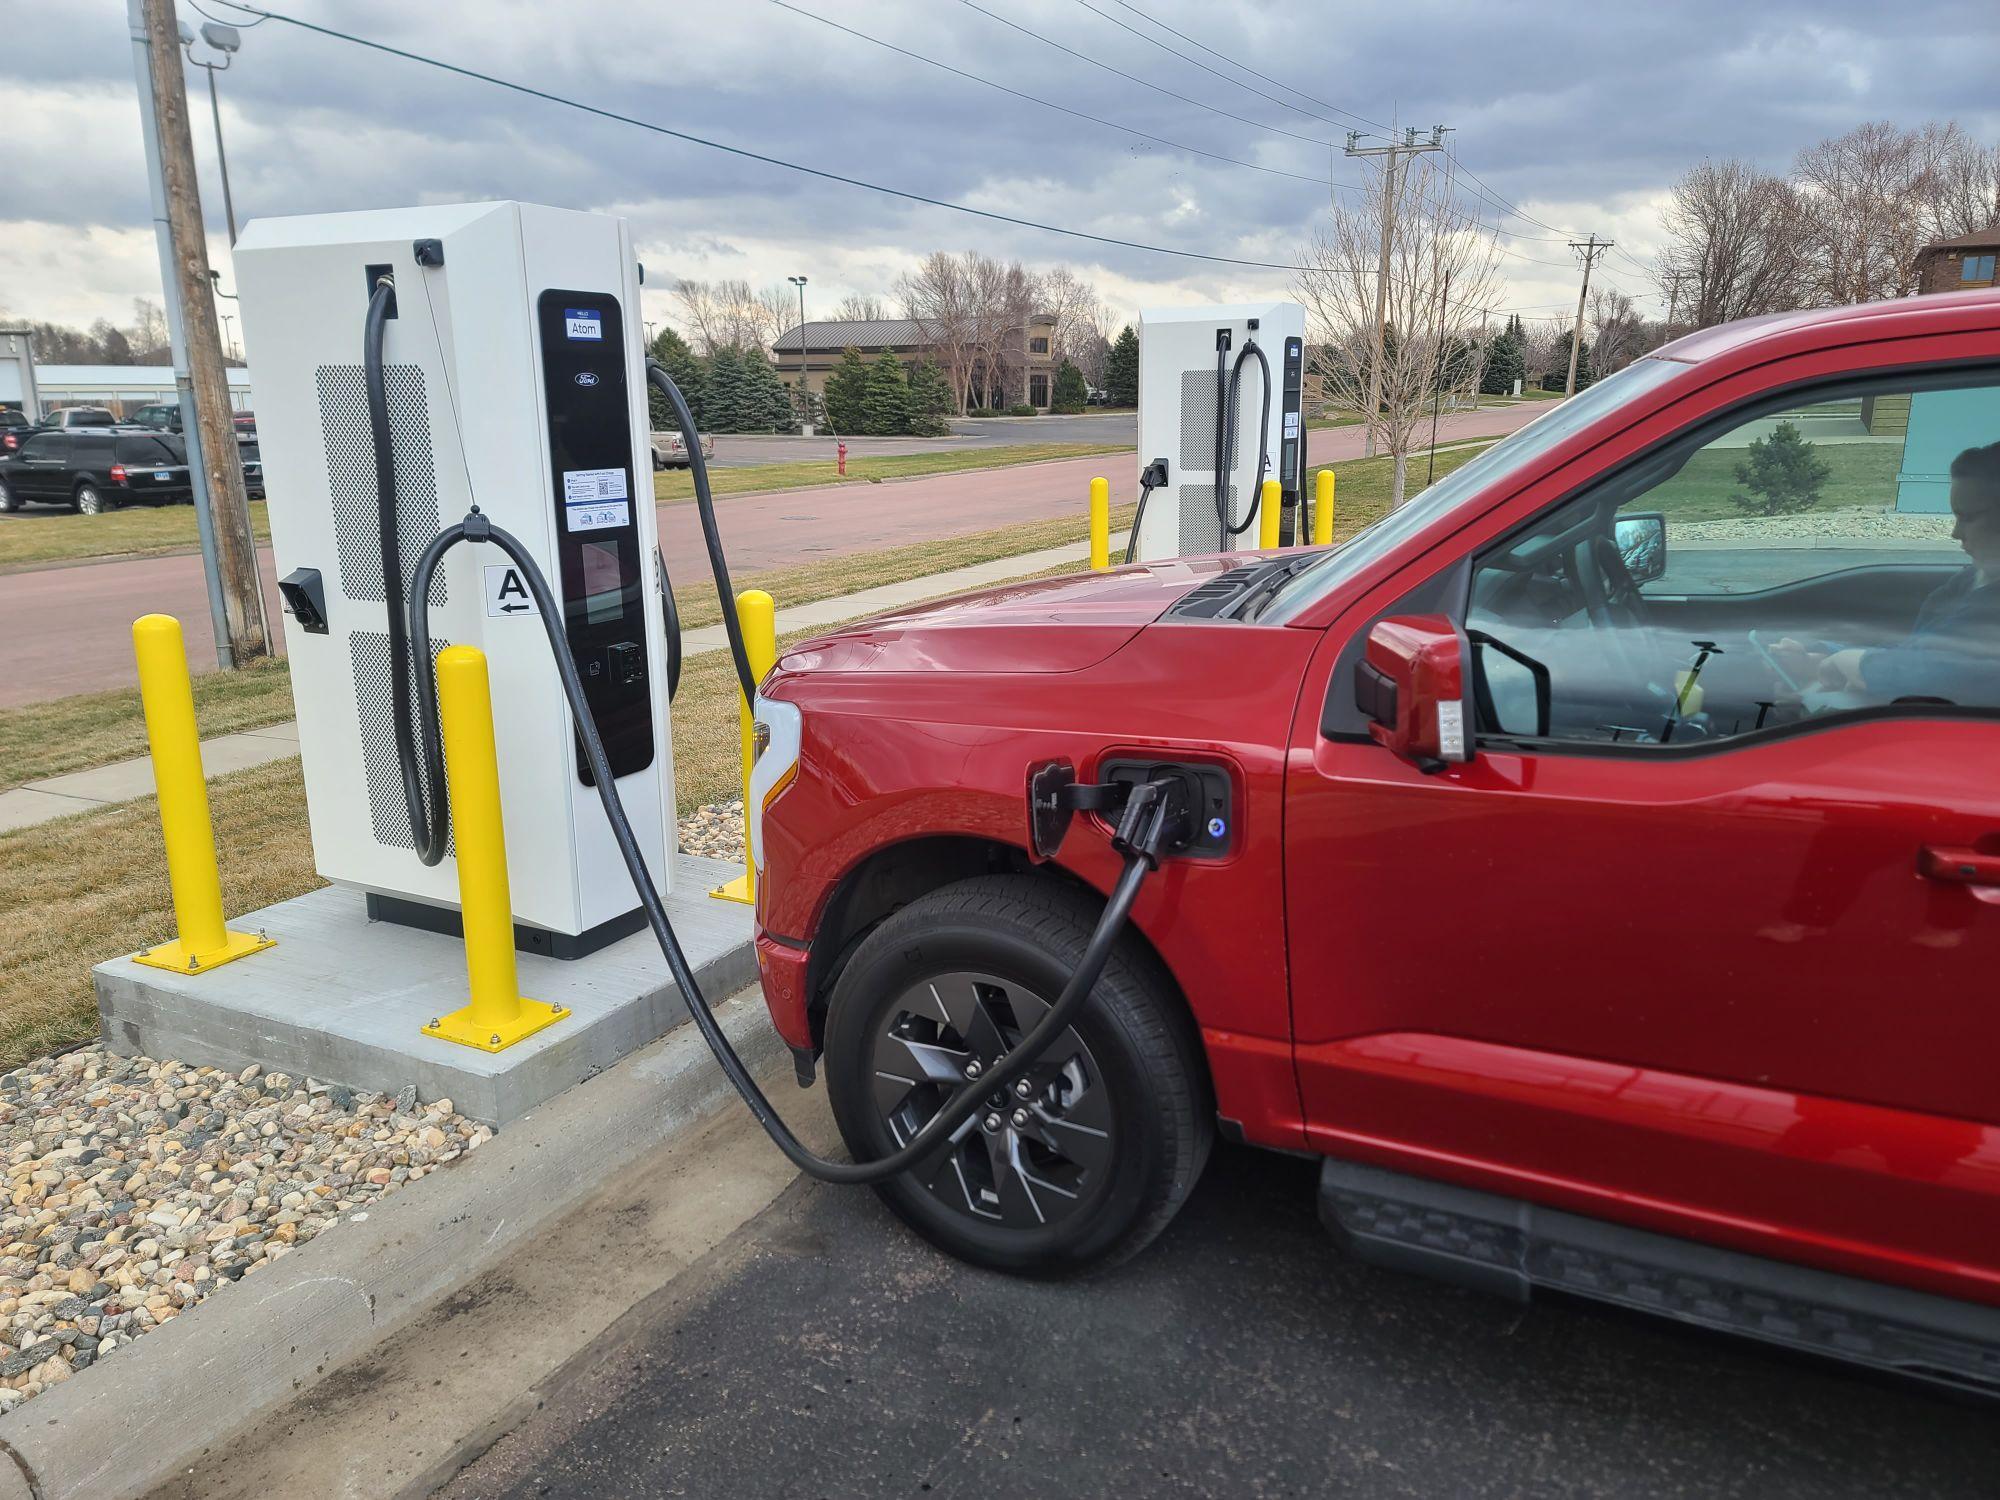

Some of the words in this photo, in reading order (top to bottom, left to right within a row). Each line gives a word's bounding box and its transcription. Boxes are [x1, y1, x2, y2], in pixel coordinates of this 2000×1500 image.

[572, 322, 597, 335] Atom
[579, 374, 595, 384] Ford
[498, 569, 529, 600] A
